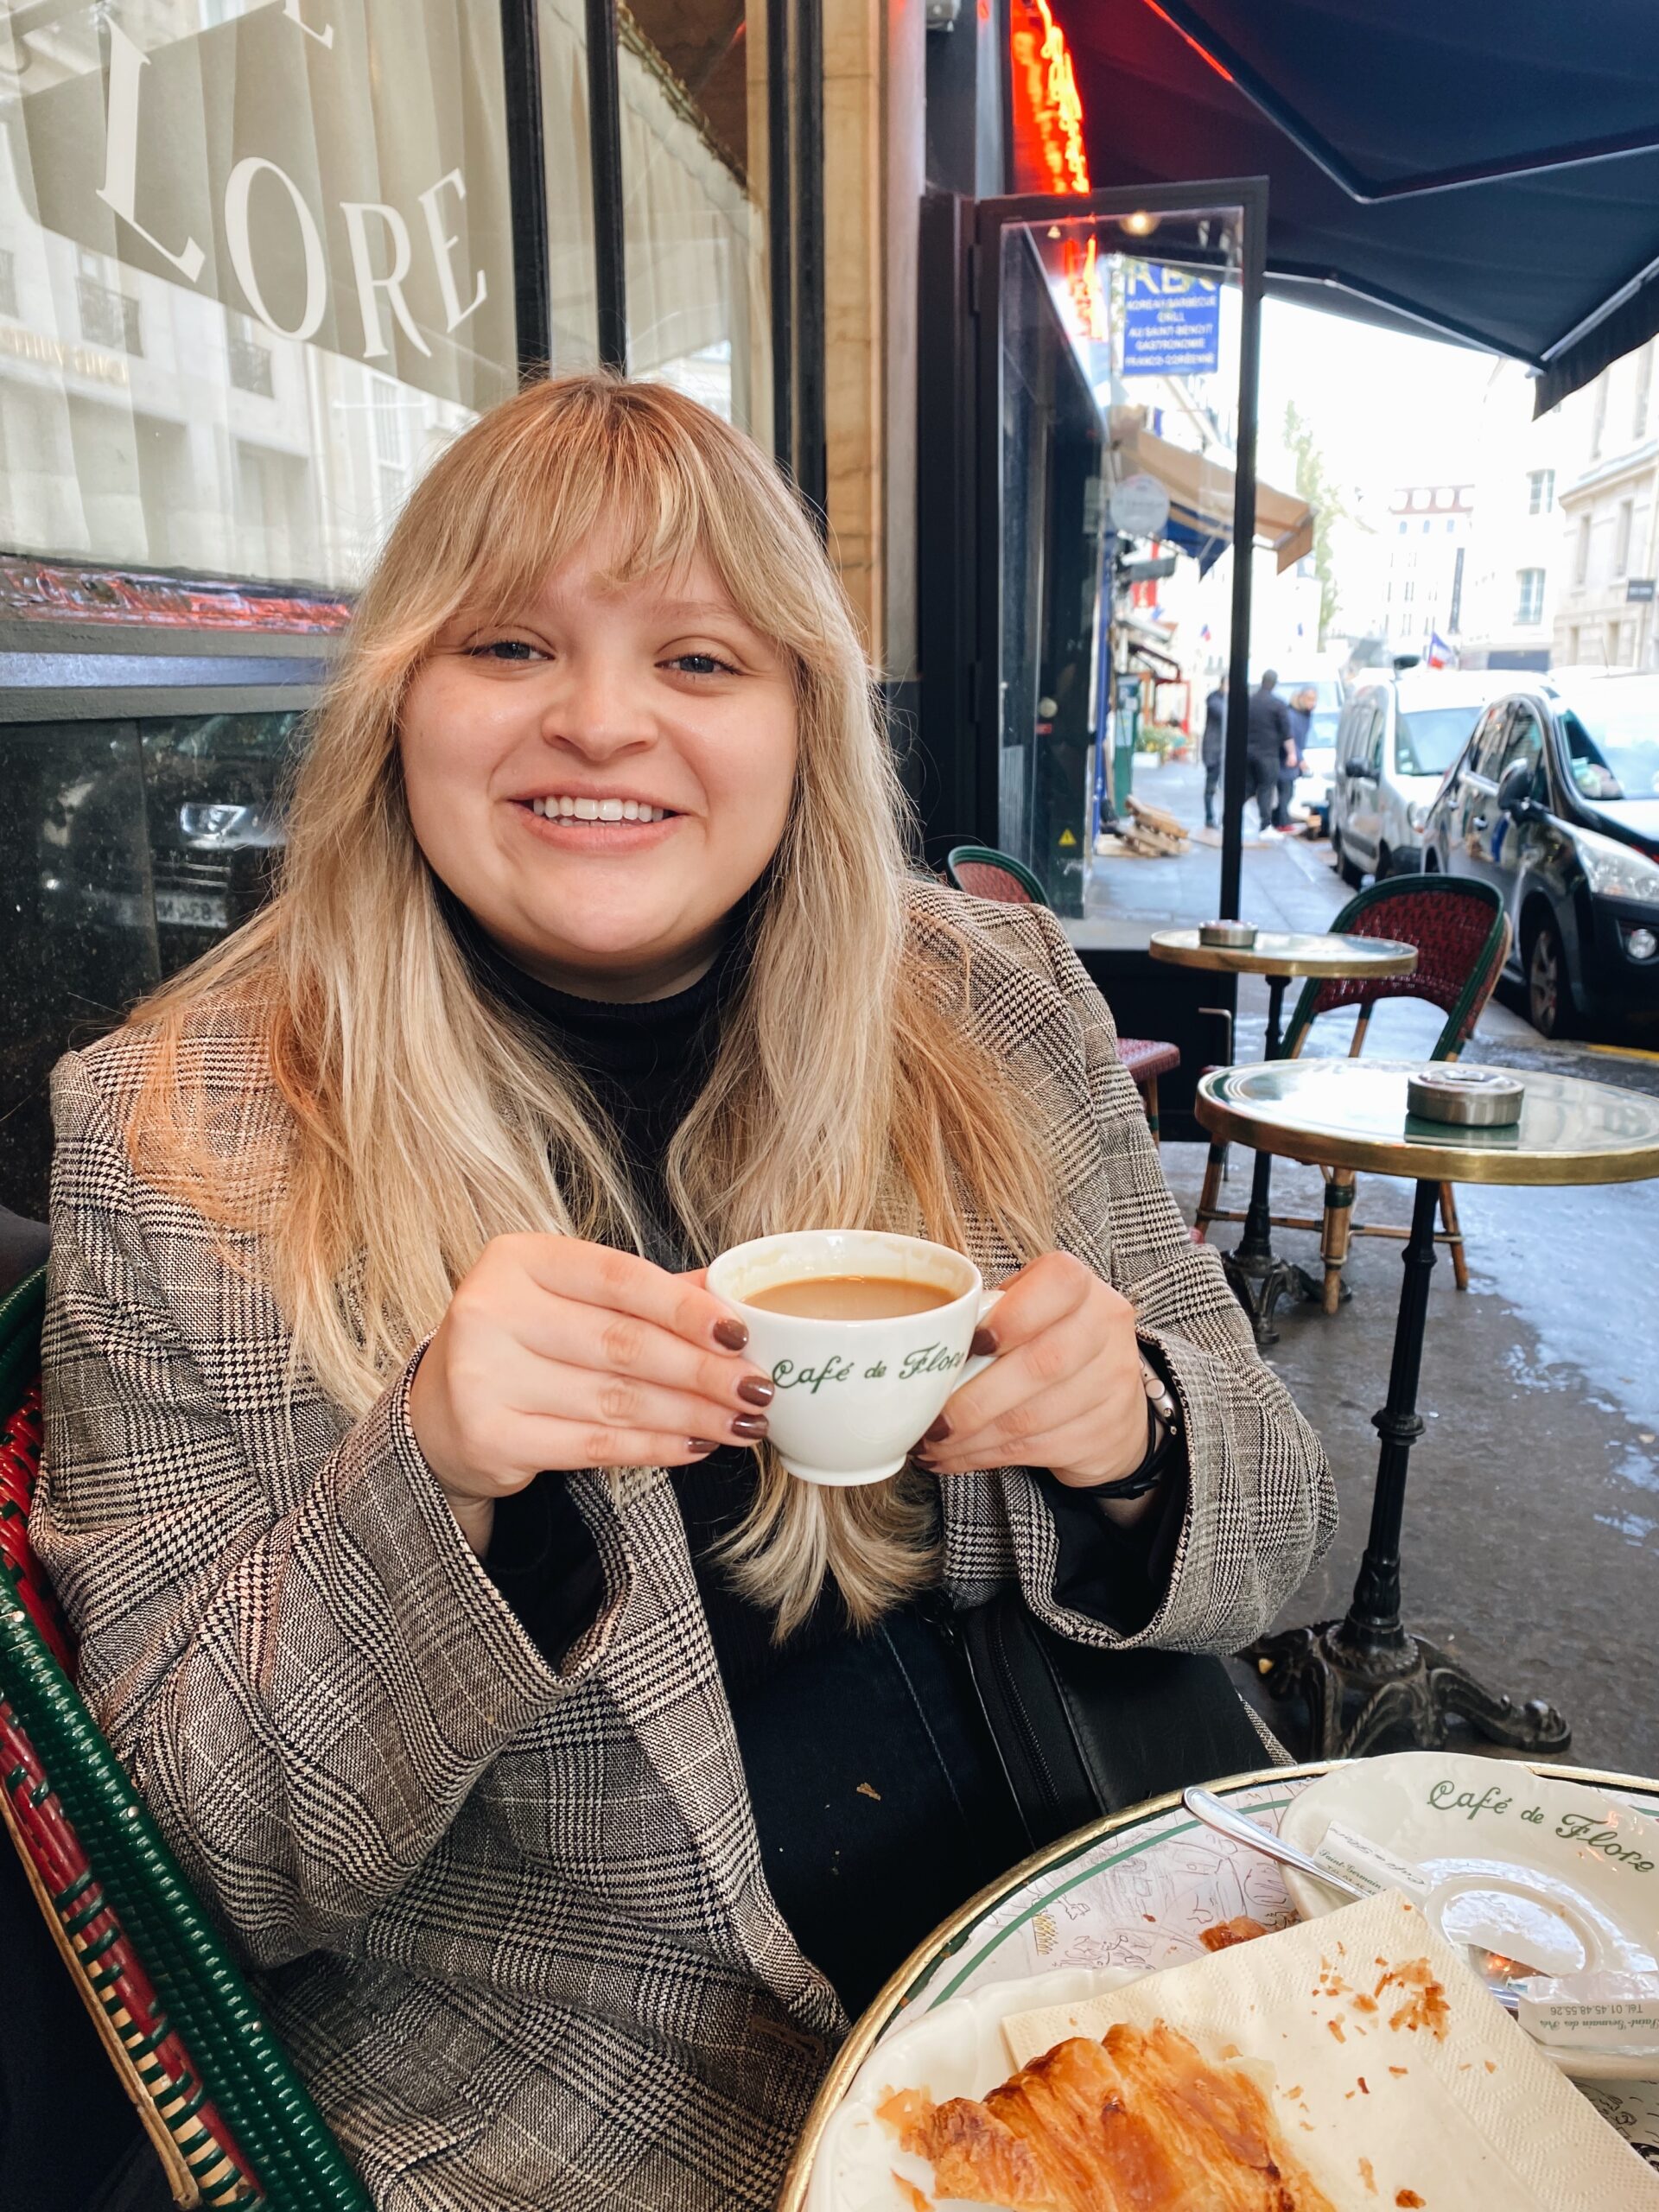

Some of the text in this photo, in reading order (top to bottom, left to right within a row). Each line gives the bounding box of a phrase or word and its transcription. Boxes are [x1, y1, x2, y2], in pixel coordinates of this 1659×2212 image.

[772, 1356, 855, 1394] Café
[864, 1361, 887, 1379] de
[1427, 1780, 1655, 1873] Café de Flore
[1550, 2005, 1623, 2016] 01.45.48.55.26
[1564, 2020, 1580, 2031] des
